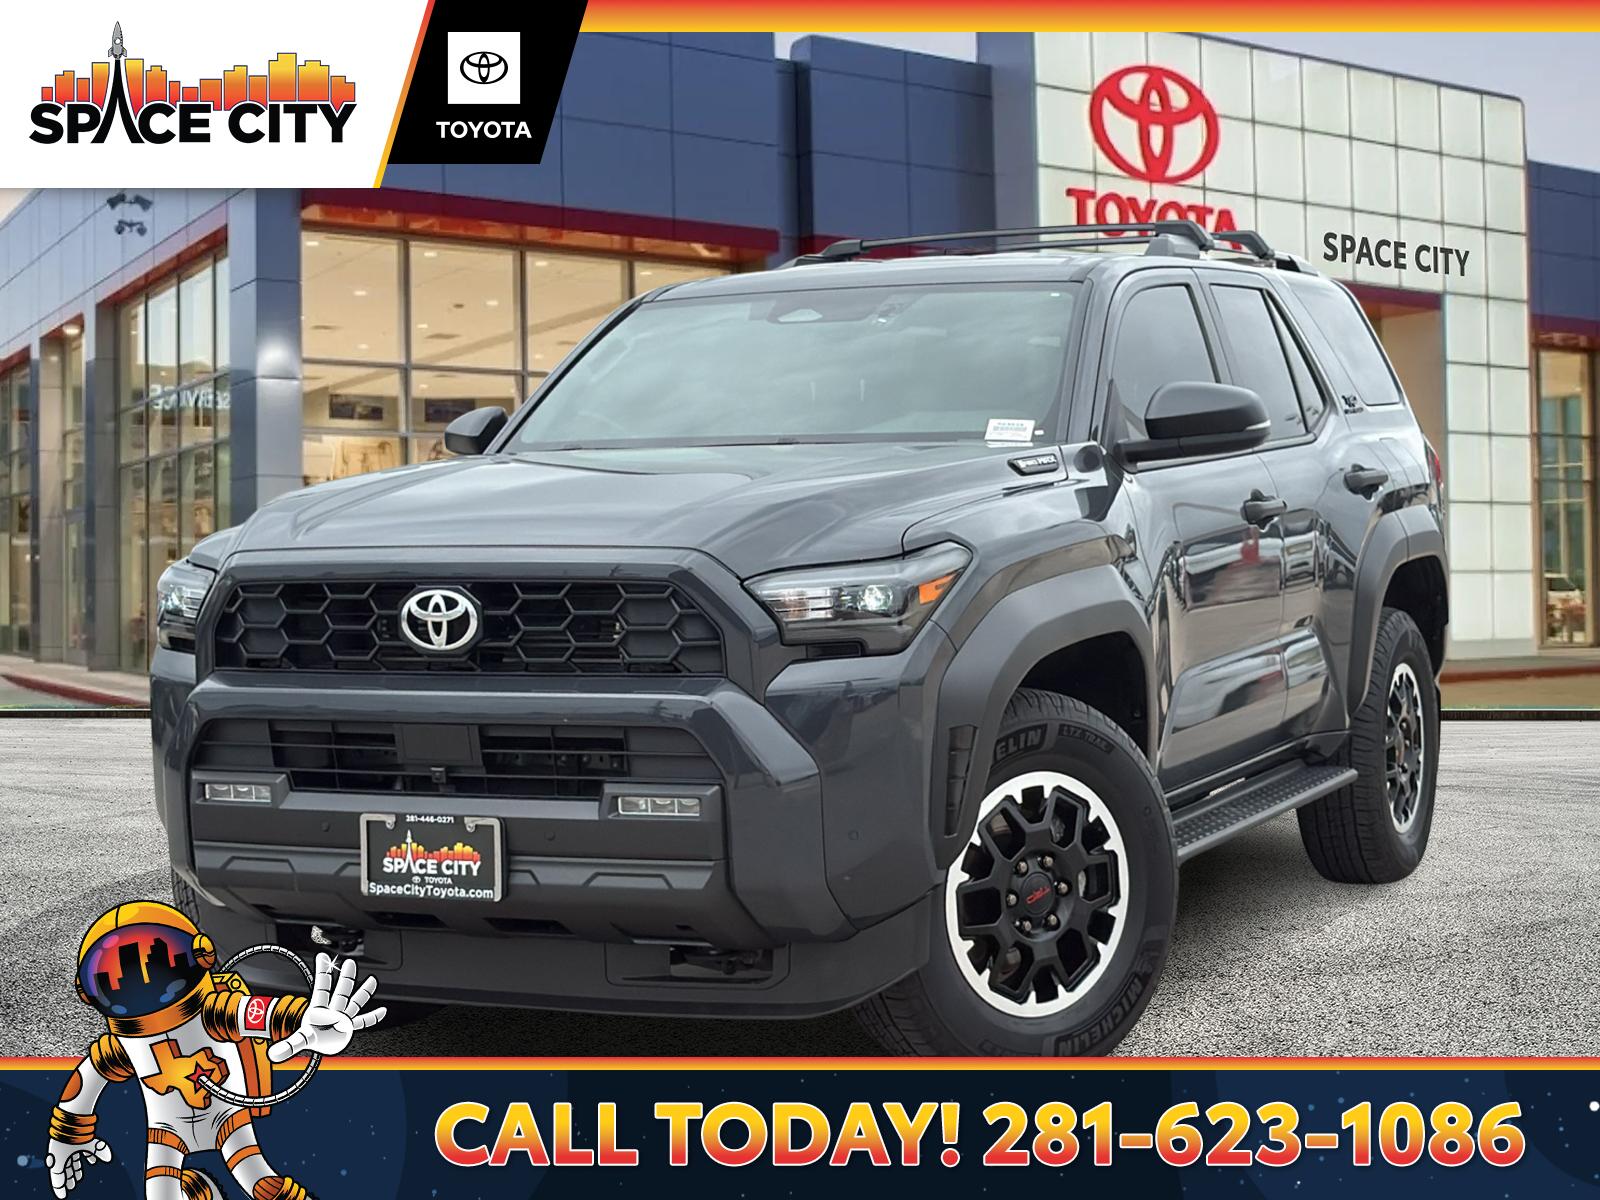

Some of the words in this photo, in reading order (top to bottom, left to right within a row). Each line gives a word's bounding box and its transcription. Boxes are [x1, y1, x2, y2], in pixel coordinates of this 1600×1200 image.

[1323, 232, 1407, 270] SPACE
[1414, 244, 1470, 277] CITY
[996, 729, 1042, 759] ELIN
[441, 859, 481, 877] CITY
[424, 875, 453, 885] TOYOTA
[369, 882, 494, 899] SpaceCityToyota.com
